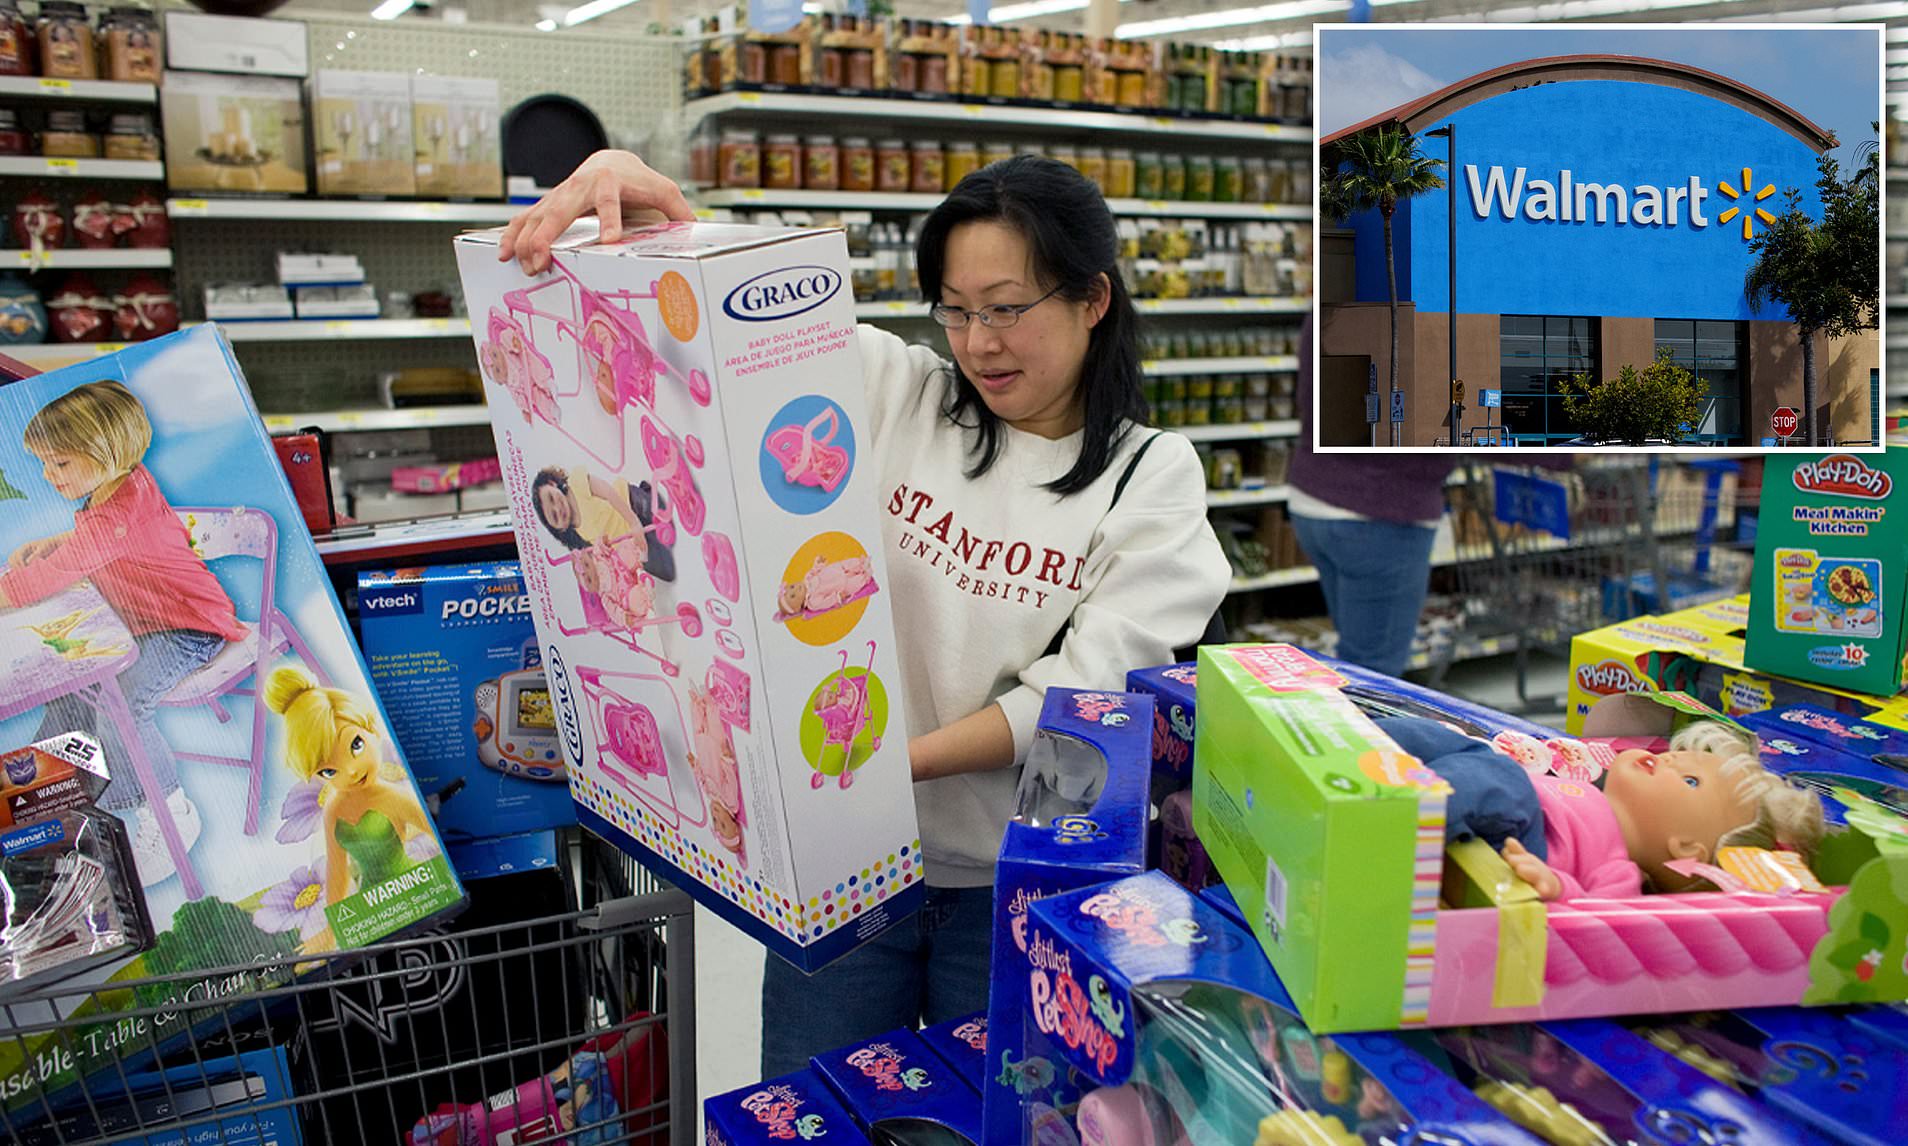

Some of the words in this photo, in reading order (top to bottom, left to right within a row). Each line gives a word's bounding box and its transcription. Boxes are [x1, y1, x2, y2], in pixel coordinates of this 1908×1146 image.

[1464, 164, 1709, 228] Walmart
[742, 273, 831, 312] GRACO
[748, 337, 771, 350] BABY
[772, 330, 796, 344] DOLL
[797, 321, 831, 337] PLAYSET
[750, 350, 763, 361] DE
[764, 343, 793, 358] JUEGO
[793, 337, 815, 349] PARA
[735, 357, 780, 377] ENSEMBLE
[1773, 416, 1796, 428] STOP
[1796, 462, 1883, 493] Play-Doh
[1794, 507, 1829, 520] Meal
[1831, 508, 1885, 521] Makin'
[888, 483, 1086, 592] STANFORD
[1811, 522, 1866, 534] Kitchen
[899, 532, 1049, 609] UNIVERSITY
[365, 594, 416, 610] vtech
[1845, 647, 1864, 661] 10
[64, 737, 98, 762] 25
[36, 778, 81, 799] WARNING:
[2, 832, 47, 850] Walmart
[362, 866, 434, 908] WARNING:
[343, 914, 377, 937] CHOKING
[1028, 929, 1073, 977] Littlest
[185, 970, 249, 1003] Chair
[1031, 970, 1064, 1036] Pet
[1055, 972, 1117, 1078] Shop
